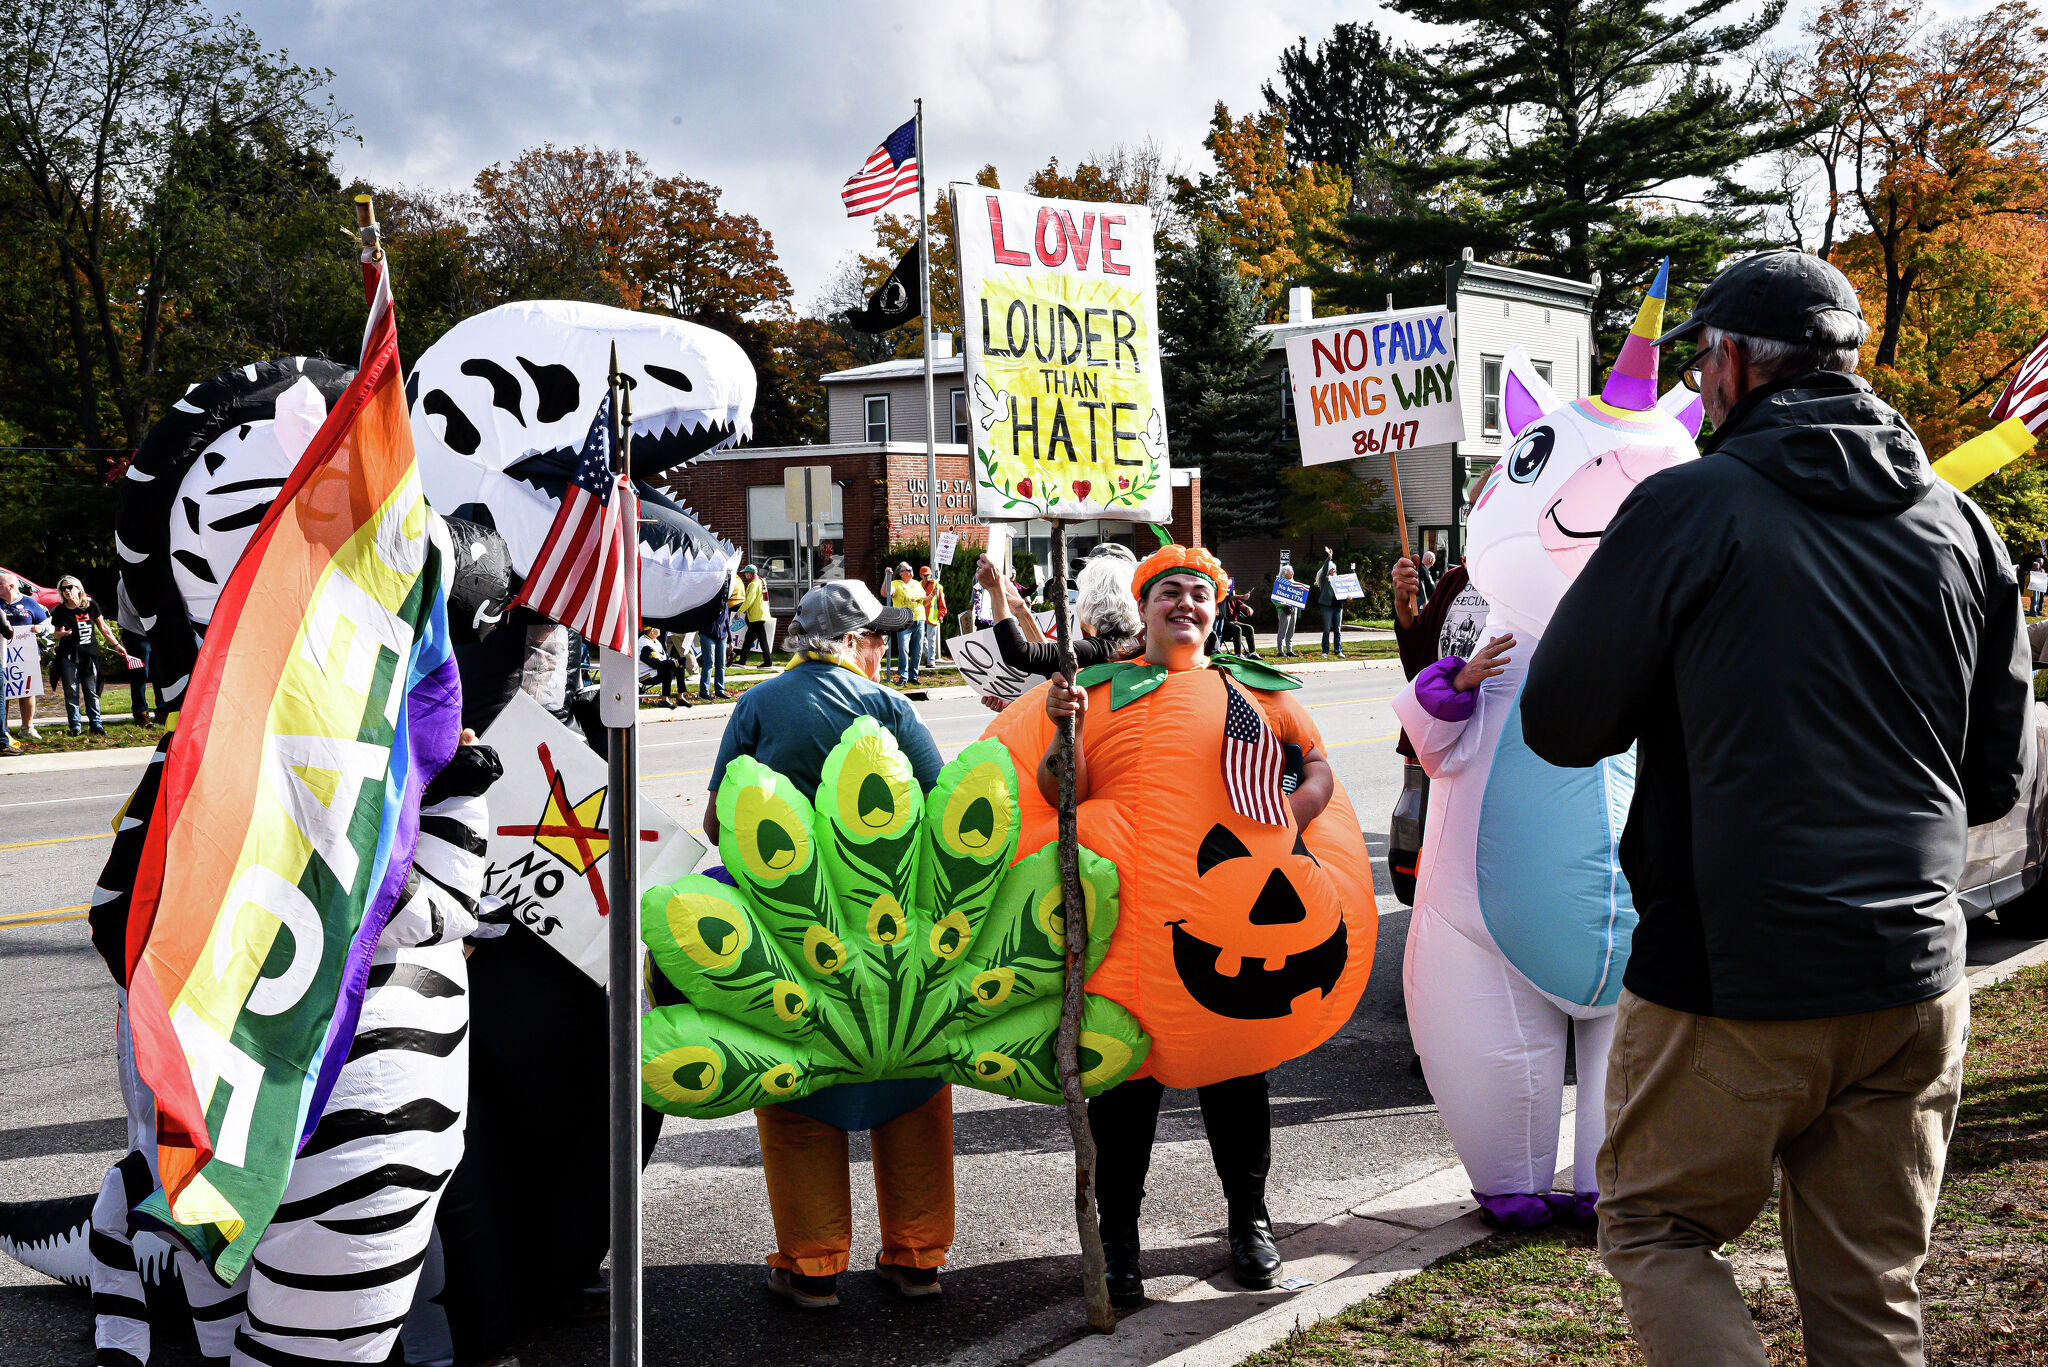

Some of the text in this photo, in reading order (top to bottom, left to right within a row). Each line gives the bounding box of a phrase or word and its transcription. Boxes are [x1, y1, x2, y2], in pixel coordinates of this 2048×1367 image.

[986, 196, 1130, 276] LOVE
[981, 298, 1140, 373] LOUDER
[1312, 315, 1447, 377] NO FAUX
[1039, 369, 1098, 398] THAN
[1310, 360, 1455, 426] KING WAY
[1011, 396, 1143, 466] HATE
[1352, 420, 1419, 455] 86/47
[908, 479, 972, 493] UNIED STA
[913, 494, 972, 507] POT OFFI
[1276, 590, 1290, 598] Since
[1287, 586, 1304, 596] Kings!
[75, 613, 92, 645] NOPE
[4, 666, 23, 681] NG
[959, 640, 993, 685] NO
[983, 661, 1031, 701] KIN
[508, 850, 564, 899] NO
[483, 862, 563, 936] KINGS
